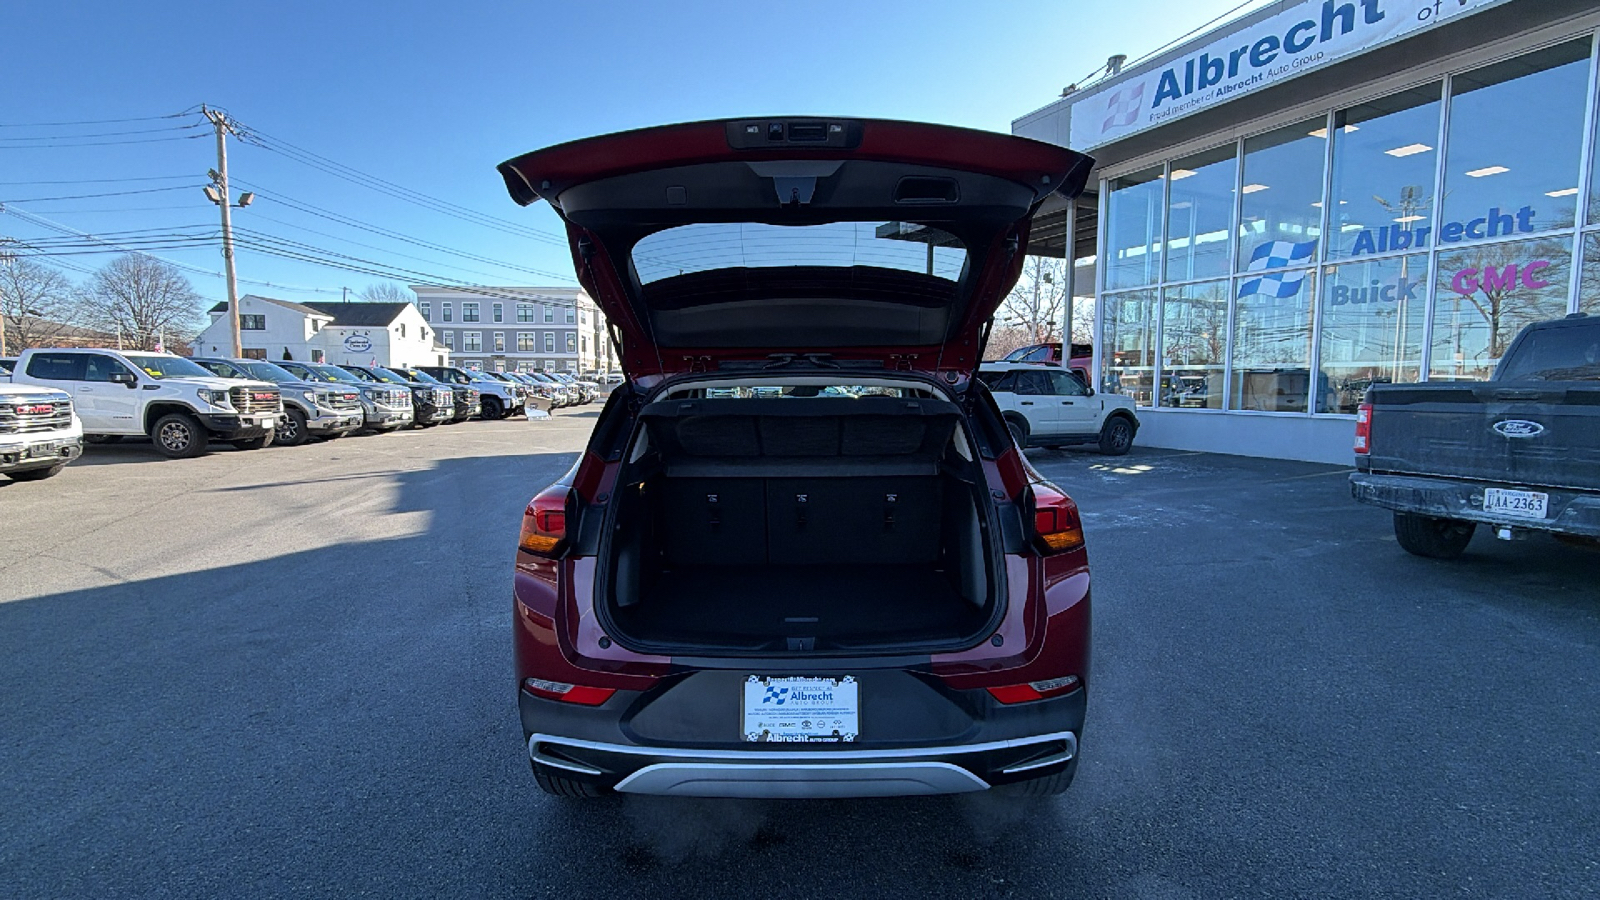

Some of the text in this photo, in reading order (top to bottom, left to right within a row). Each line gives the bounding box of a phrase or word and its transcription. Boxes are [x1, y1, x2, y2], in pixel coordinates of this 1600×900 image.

[1152, 0, 1386, 109] Albrecht
[1149, 51, 1324, 122] Proud member of Albrecht Auto Group
[1352, 205, 1536, 256] Albrecht
[1331, 260, 1550, 306] Buick GMC
[17, 404, 53, 414] GMC
[790, 691, 834, 701] Albrecht
[766, 733, 809, 742] Albrecht
